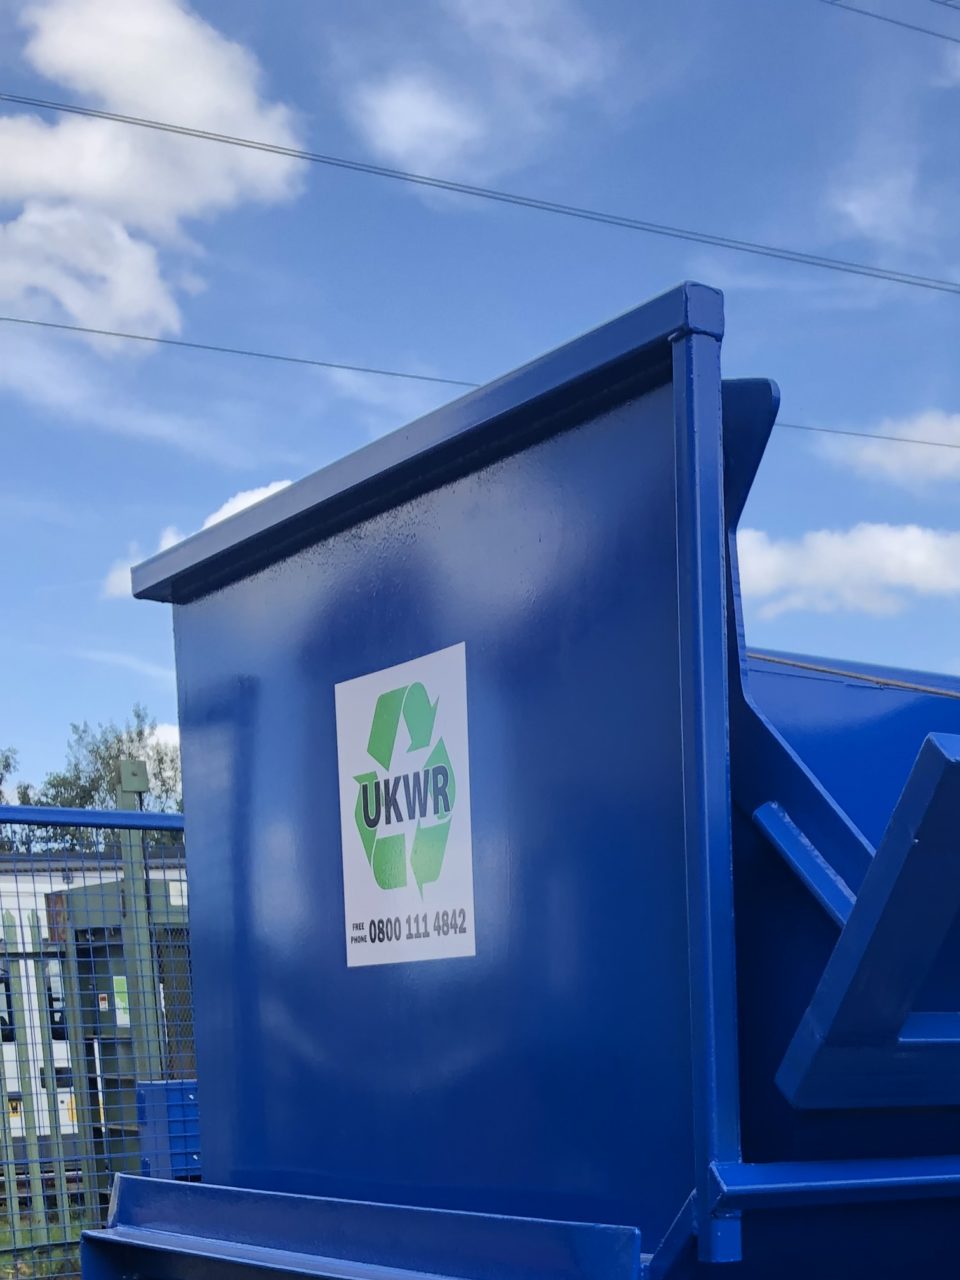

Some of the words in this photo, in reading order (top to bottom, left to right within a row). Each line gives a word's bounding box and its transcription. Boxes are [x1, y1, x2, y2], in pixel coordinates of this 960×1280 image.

[361, 765, 450, 829] UKWR
[352, 922, 365, 931] FREE
[369, 917, 401, 943] 0800
[406, 913, 430, 939] 111
[433, 908, 467, 936] 4842
[351, 935, 367, 944] PHONE
